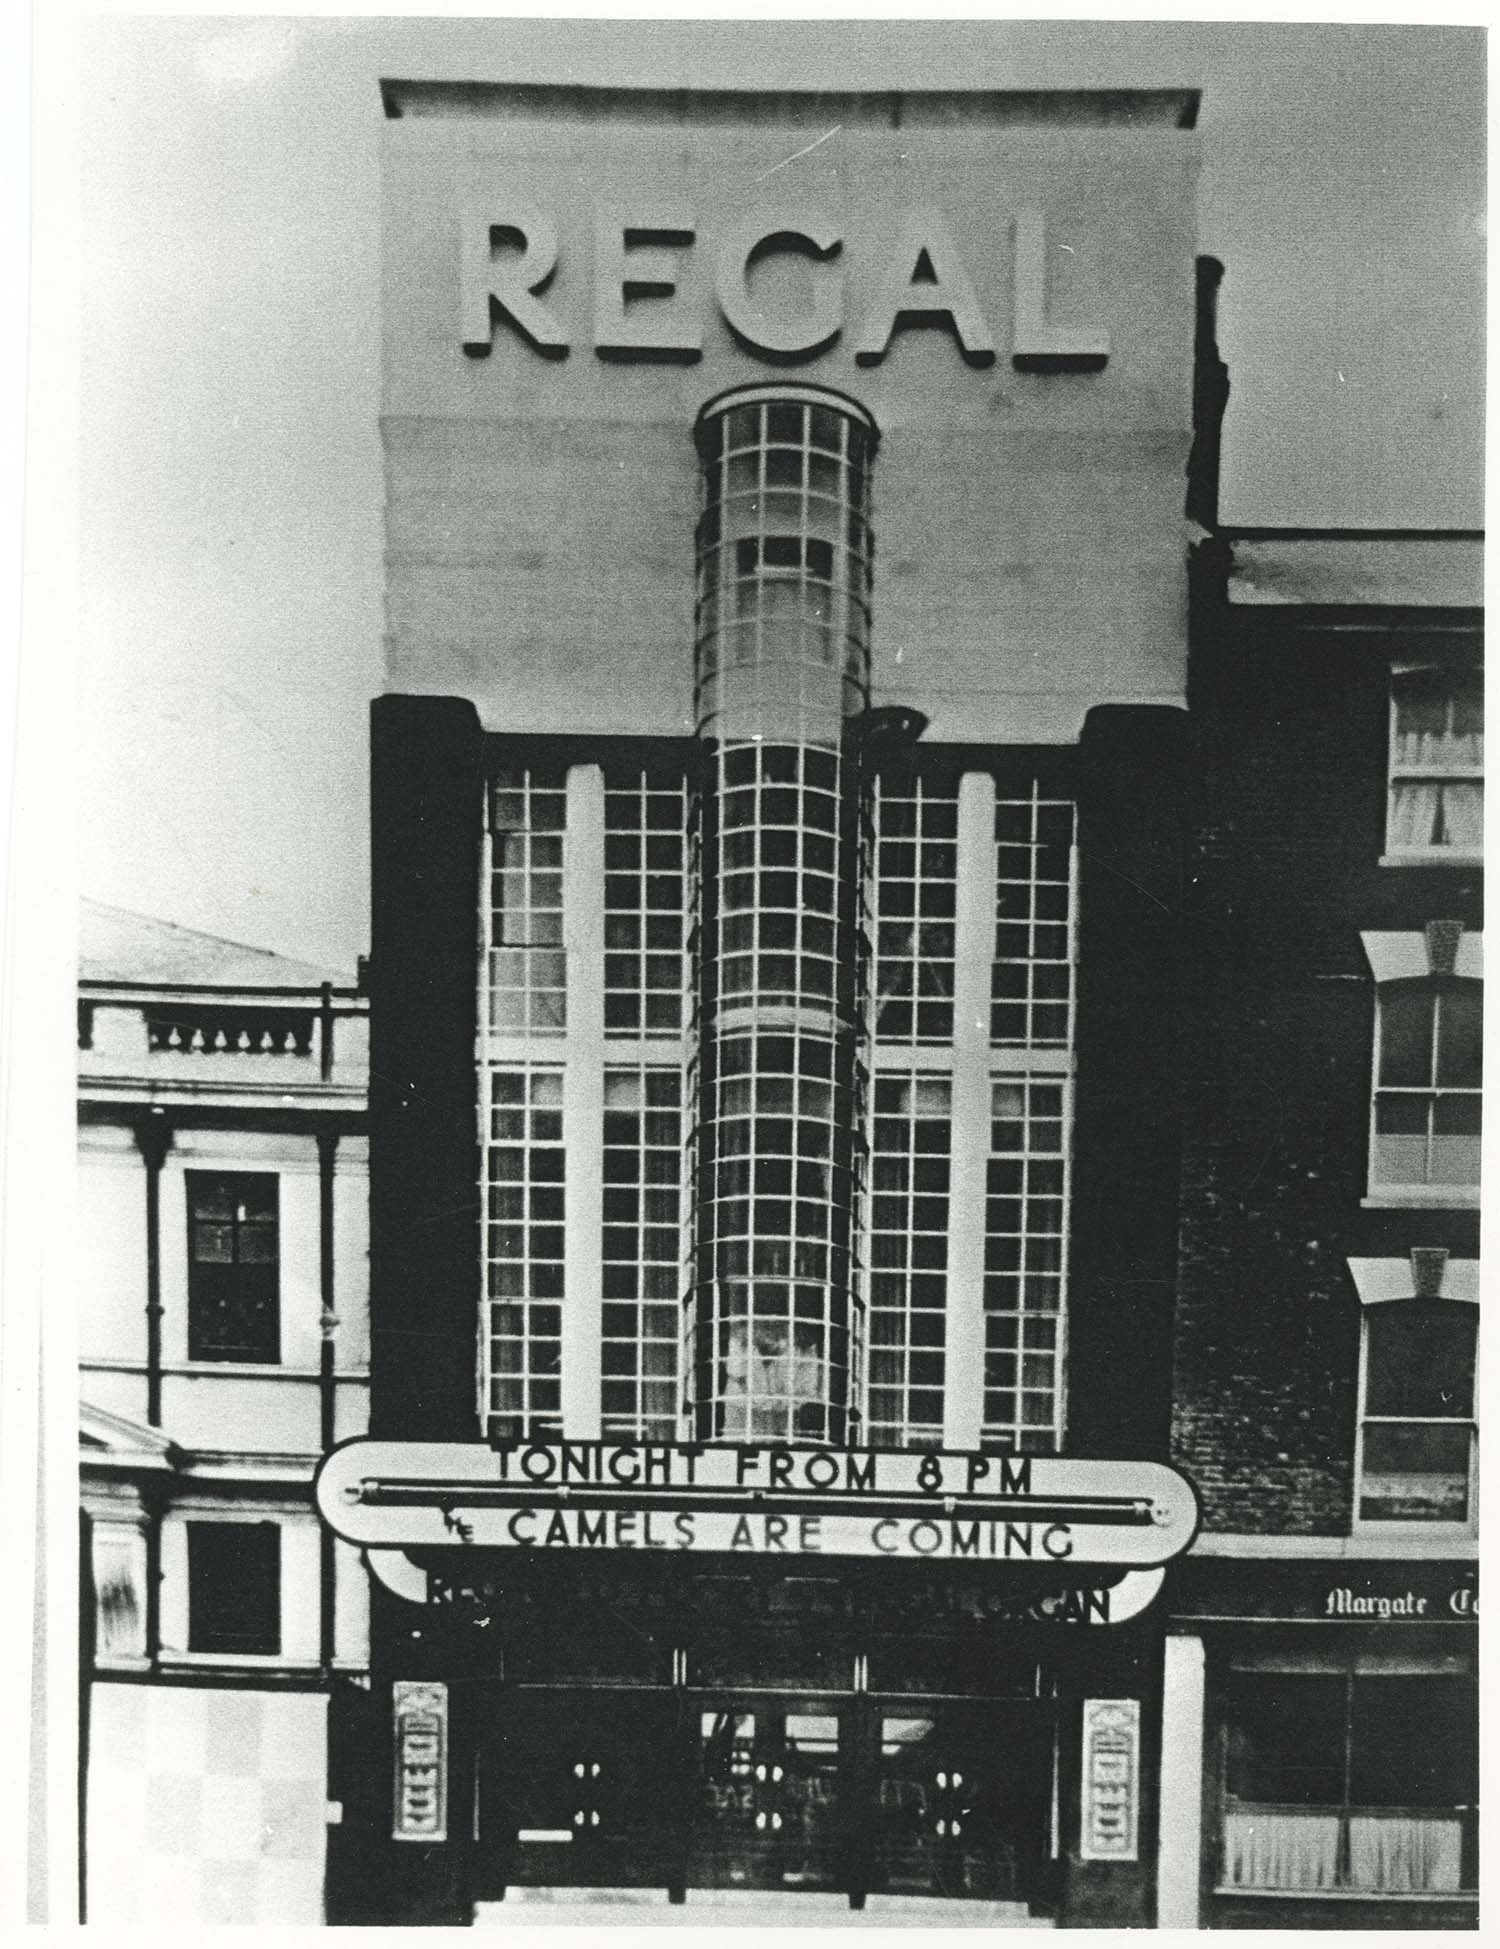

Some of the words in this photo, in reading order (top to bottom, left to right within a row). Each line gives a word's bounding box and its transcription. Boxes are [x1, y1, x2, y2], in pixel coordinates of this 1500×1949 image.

[460, 208, 1110, 372] REGAL
[491, 1443, 704, 1483] TONIGHT
[736, 1450, 876, 1488] FROM
[916, 1455, 943, 1493] 8
[967, 1455, 1032, 1494] PM
[508, 1508, 695, 1548] CAMELS
[731, 1515, 821, 1551] ARE
[871, 1519, 1074, 1558] COMING
[1325, 1588, 1428, 1618] Margate
